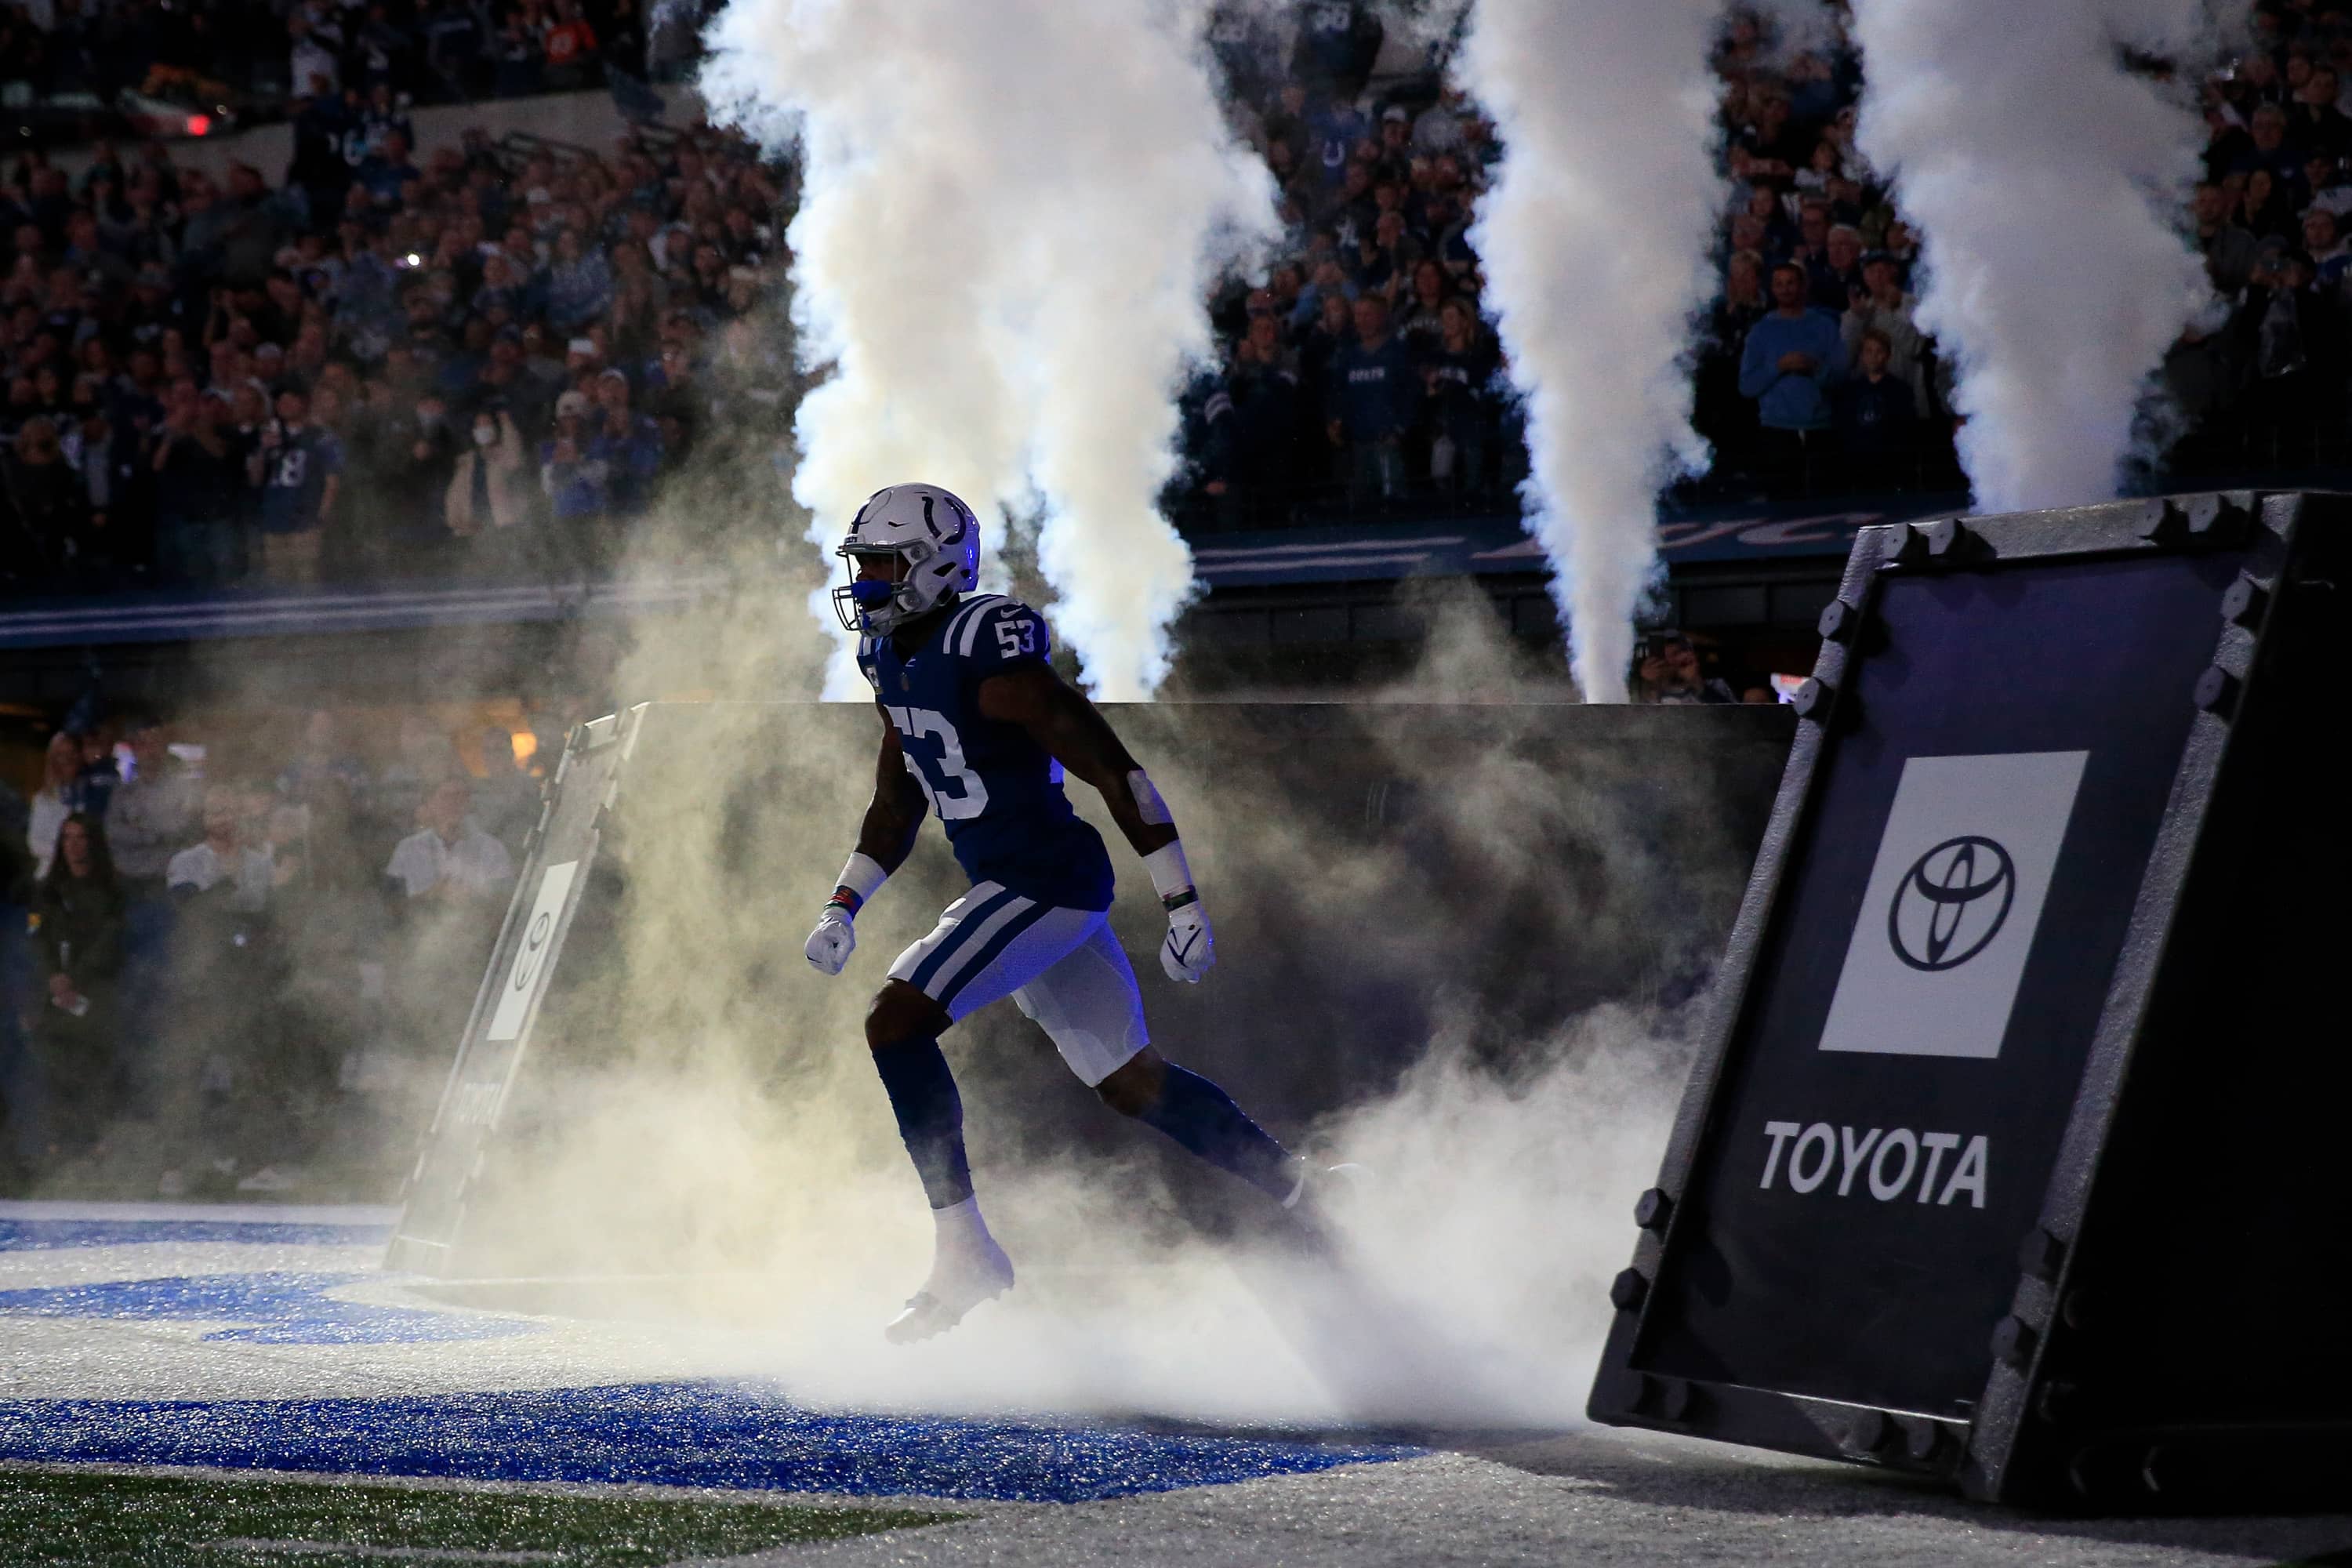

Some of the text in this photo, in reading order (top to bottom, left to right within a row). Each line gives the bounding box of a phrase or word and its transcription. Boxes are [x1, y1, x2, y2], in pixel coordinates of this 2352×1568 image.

[994, 619, 1036, 659] 53
[884, 704, 989, 820] 53
[1759, 1120, 1990, 1209] TOYOTA
